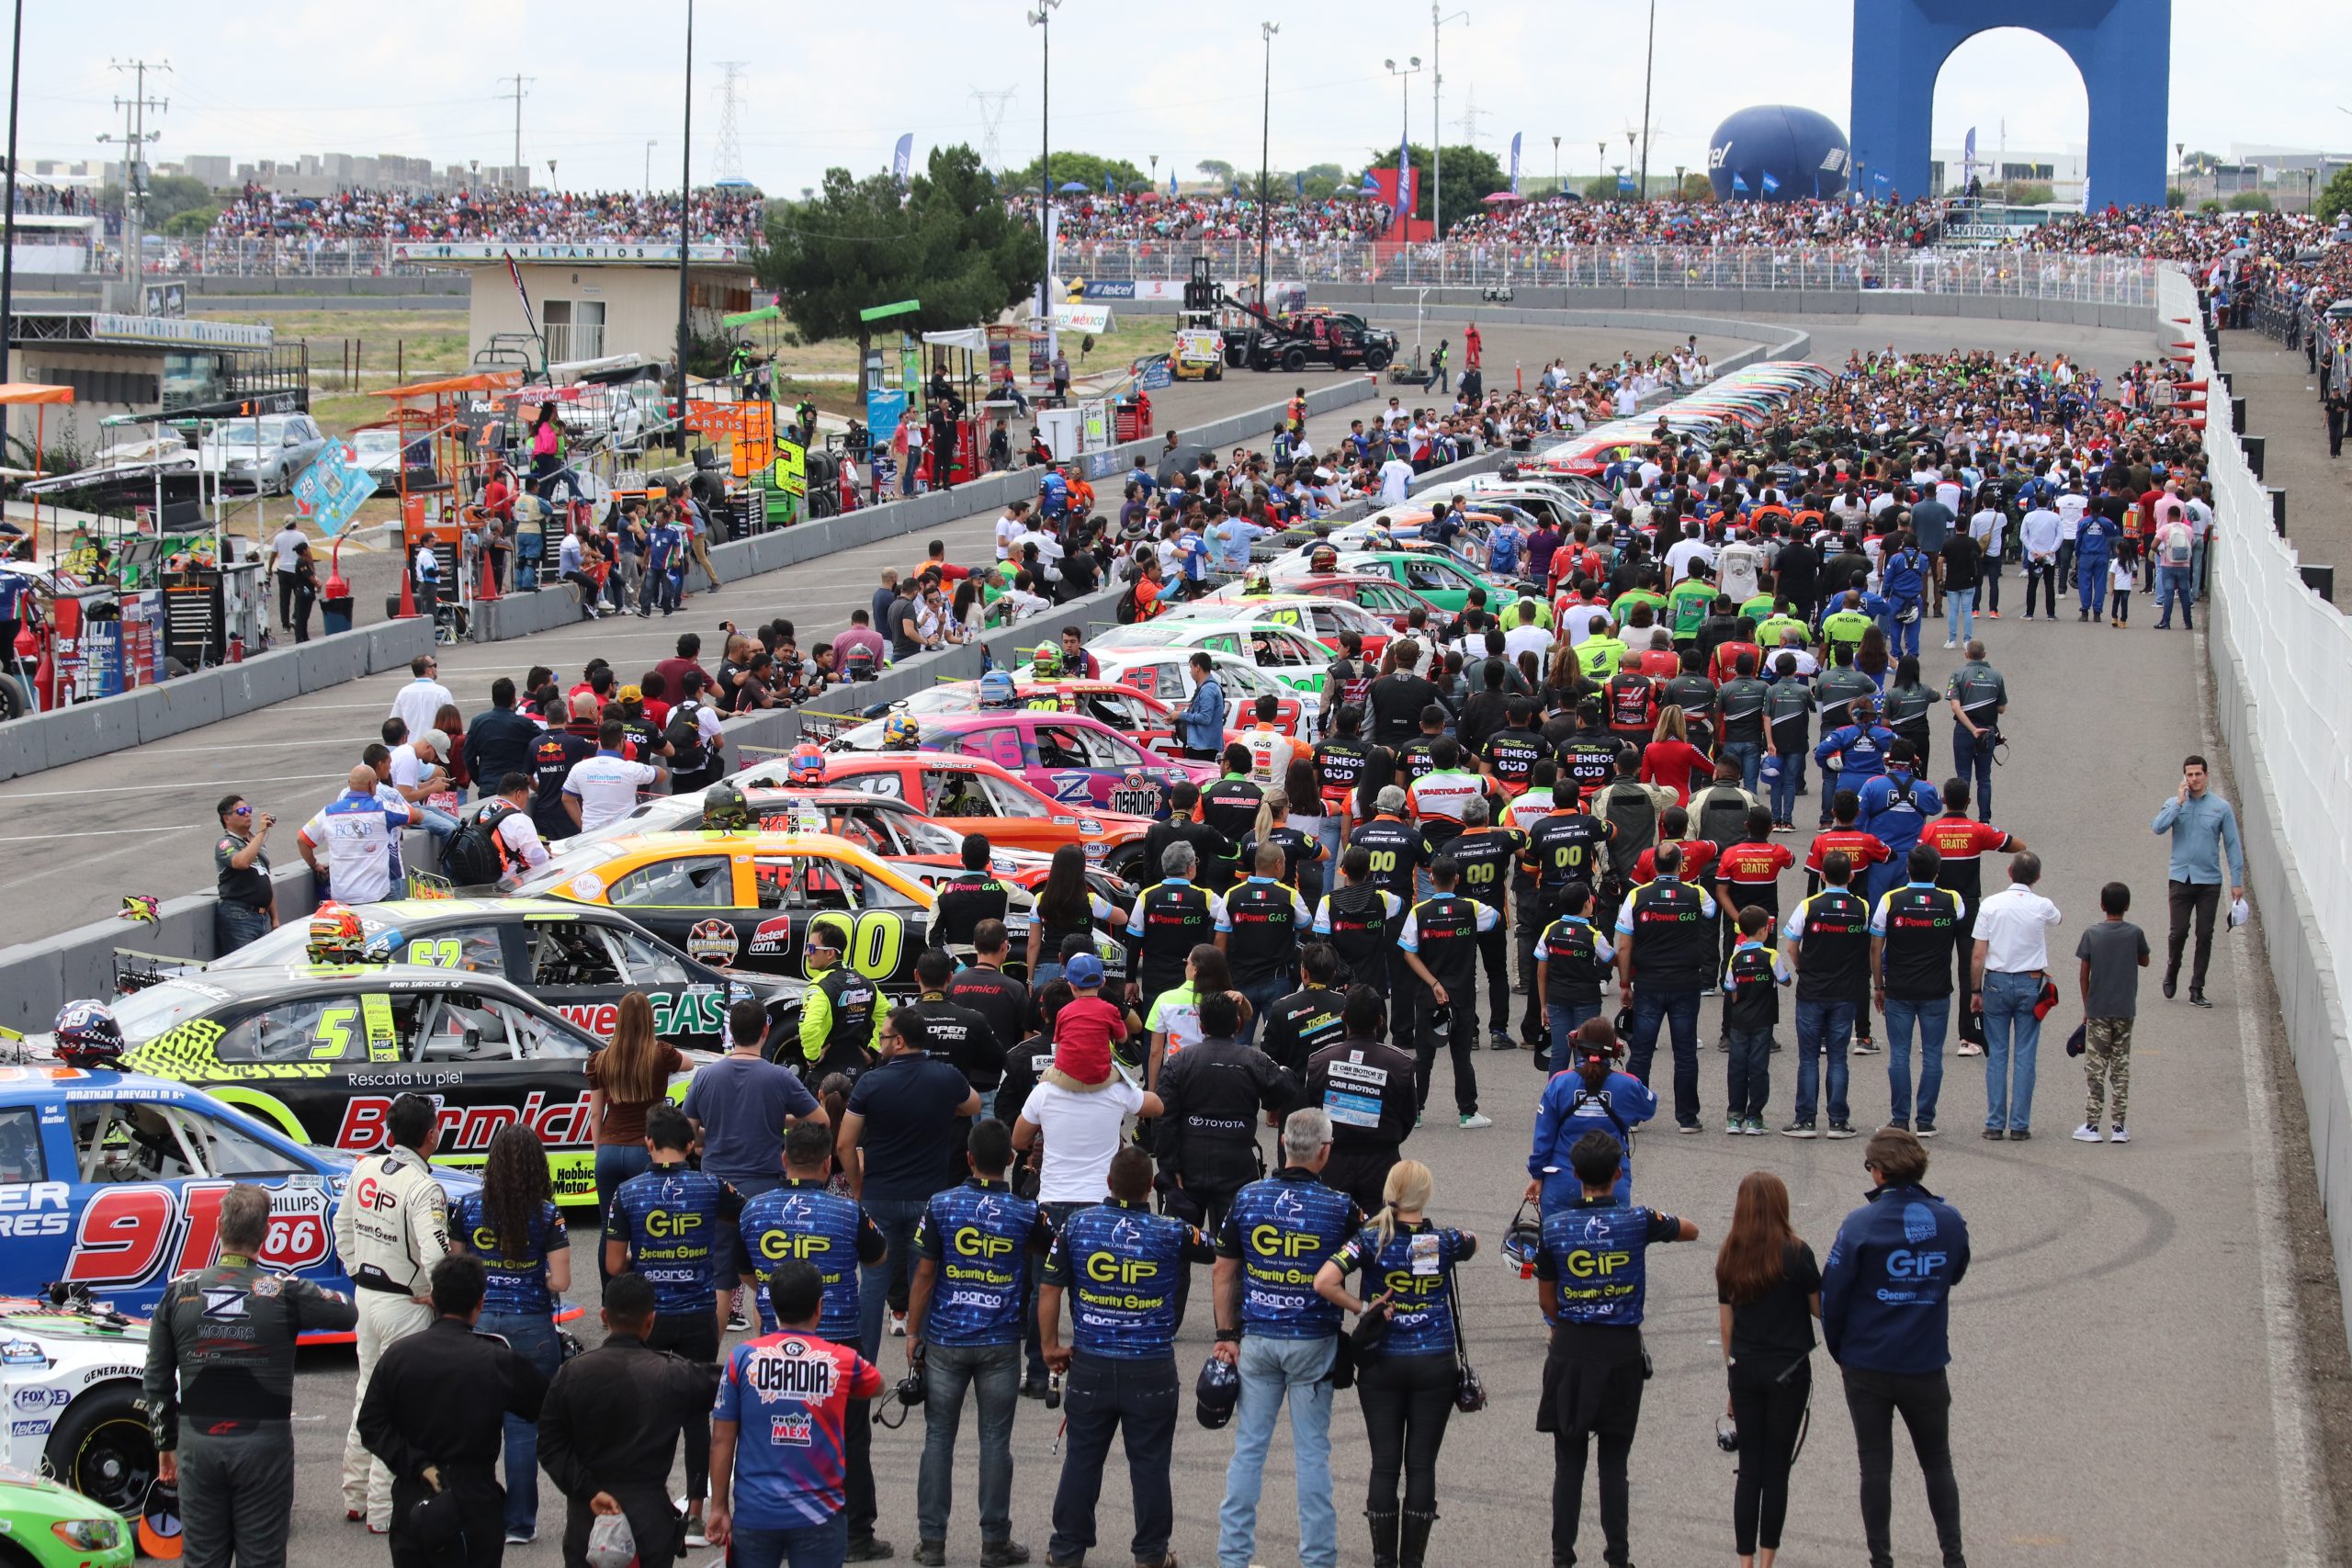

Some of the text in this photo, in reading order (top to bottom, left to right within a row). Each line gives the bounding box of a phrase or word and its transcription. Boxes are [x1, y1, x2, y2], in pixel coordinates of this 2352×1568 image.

[485, 246, 645, 258] SANITARIOS
[1102, 284, 1135, 297] telcel
[470, 400, 504, 413] FedEx
[689, 419, 743, 430] ARRIS
[58, 638, 74, 653] 25
[626, 733, 648, 744] EOS
[1501, 748, 1538, 759] ENEOS
[1576, 754, 1614, 763] ENEOS
[1327, 755, 1365, 768] ENEOS
[540, 765, 557, 773] Mobil
[429, 799, 454, 809] SEARS
[1514, 806, 1559, 815] TRAKTOLA
[1940, 839, 1968, 850] GRATIS
[1369, 851, 1396, 872] 00
[1555, 845, 1581, 867] 00
[1467, 863, 1494, 884] 00
[1741, 863, 1770, 874] GRATIS
[754, 928, 787, 942] foster
[1306, 1011, 1332, 1029] TIGER
[308, 1007, 358, 1059] 5
[927, 1025, 967, 1034] OPER
[1352, 1067, 1377, 1077] MOTION
[348, 1070, 463, 1088] Rescata tu piel
[1329, 1079, 1380, 1095] CAR MOTION
[66, 1090, 114, 1100] JONATHAN
[116, 1090, 157, 1100] AREVALO
[161, 1090, 170, 1100] M
[335, 1090, 594, 1152] Brmici
[1204, 1118, 1246, 1129] TOYOTA
[553, 1179, 589, 1194] Motor
[269, 1197, 319, 1212] HILLIPS
[266, 1220, 316, 1255] 66
[639, 1247, 675, 1259] Security
[645, 1269, 694, 1282] sparco
[946, 1265, 986, 1281] Security
[1247, 1263, 1284, 1283] Security
[1286, 1269, 1315, 1284] Spe
[487, 1275, 522, 1285] arco
[952, 1290, 1001, 1308] sparco
[1079, 1289, 1123, 1308] Security
[1250, 1289, 1306, 1309] sparco
[198, 1324, 255, 1340] MOTORS
[757, 1358, 830, 1394] OSADÍA
[21, 1391, 46, 1403] FOX
[12, 1420, 51, 1437] telcel
